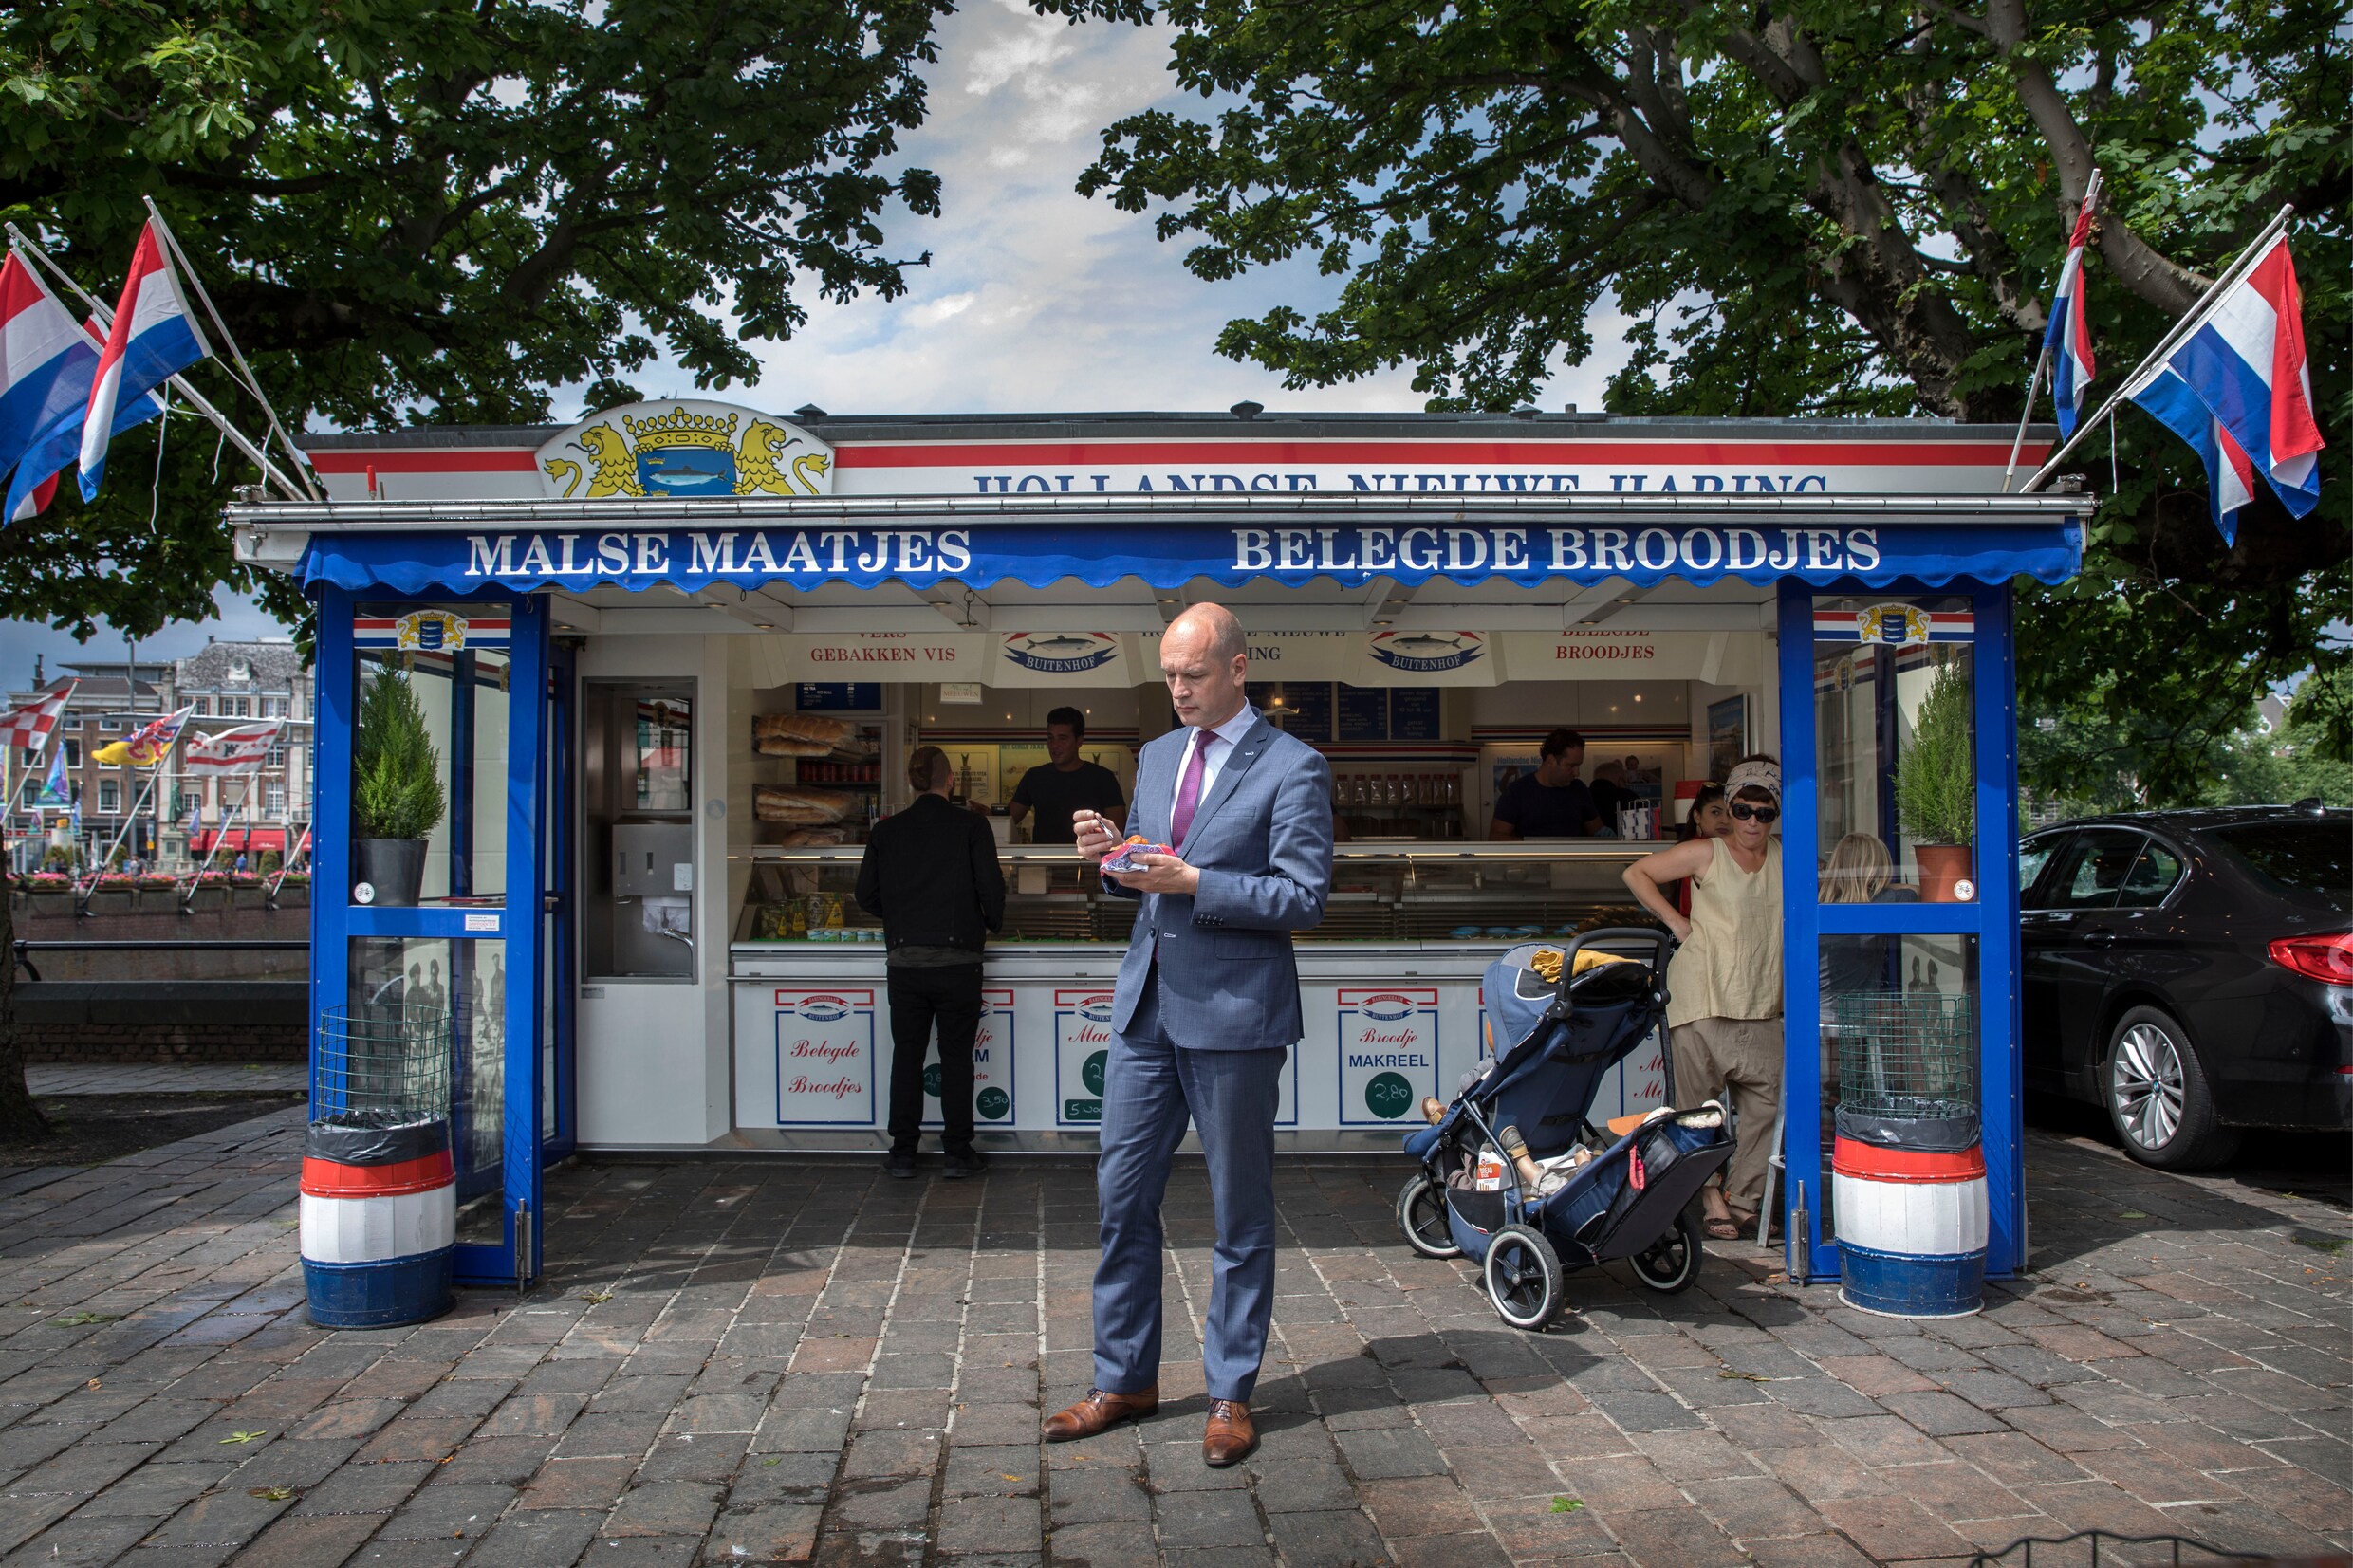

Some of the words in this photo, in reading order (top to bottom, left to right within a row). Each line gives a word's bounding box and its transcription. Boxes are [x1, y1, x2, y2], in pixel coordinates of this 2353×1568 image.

[465, 532, 670, 577] MALSE
[686, 530, 972, 574] MAATJES
[1232, 528, 1528, 570] BELEGDE
[1547, 528, 1881, 572] BROODJES
[810, 647, 916, 662] GEBAKKEN
[924, 647, 956, 662] VIS
[1248, 646, 1282, 661] ING
[1555, 645, 1655, 660] BROODJES
[1026, 655, 1096, 672] BUITENHOF
[1392, 655, 1462, 670] BUITENHOF
[1496, 756, 1529, 765] Hollandse
[1531, 756, 1542, 765] Nie
[807, 1013, 840, 1022] BUITENHOF
[1371, 1012, 1404, 1021] BUITENHOF
[1359, 1027, 1418, 1049] Broodje
[790, 1039, 860, 1065] Belegde
[1349, 1054, 1430, 1068] MAKREEL
[788, 1075, 862, 1100] Broodjes
[924, 1072, 941, 1088] 2,8
[1374, 1083, 1409, 1102] 2,80
[981, 1095, 1009, 1108] 3,50
